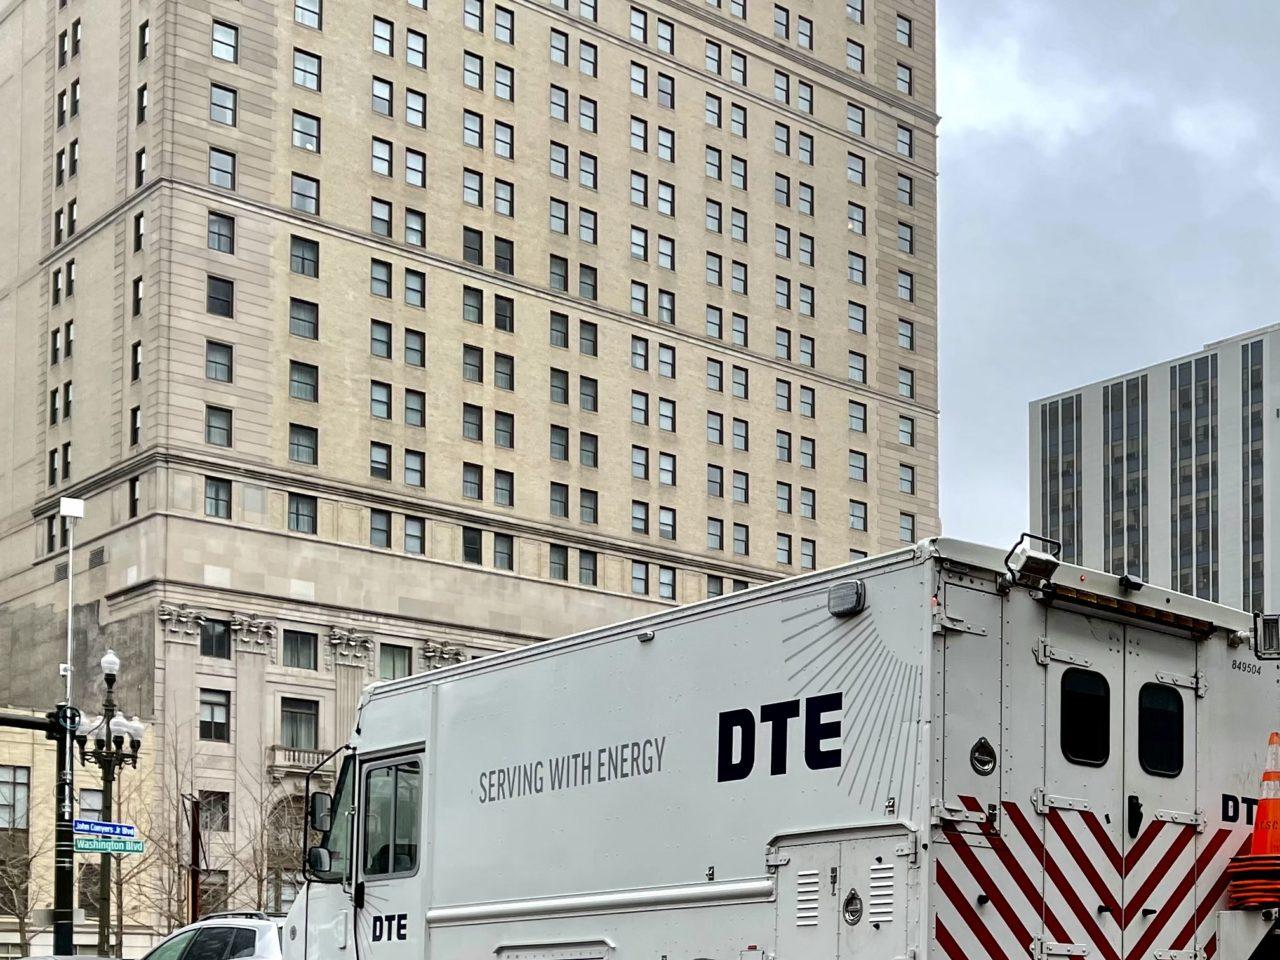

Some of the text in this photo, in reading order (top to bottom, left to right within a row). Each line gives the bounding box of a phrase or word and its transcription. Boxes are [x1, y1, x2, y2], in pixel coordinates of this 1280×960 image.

[1231, 659, 1262, 676] 849504
[717, 692, 843, 783] DTE
[479, 736, 666, 804] SERVING WITH ENERGY
[1222, 793, 1258, 826] DT
[76, 840, 143, 852] Washington Blvd
[372, 913, 407, 942] DTE
